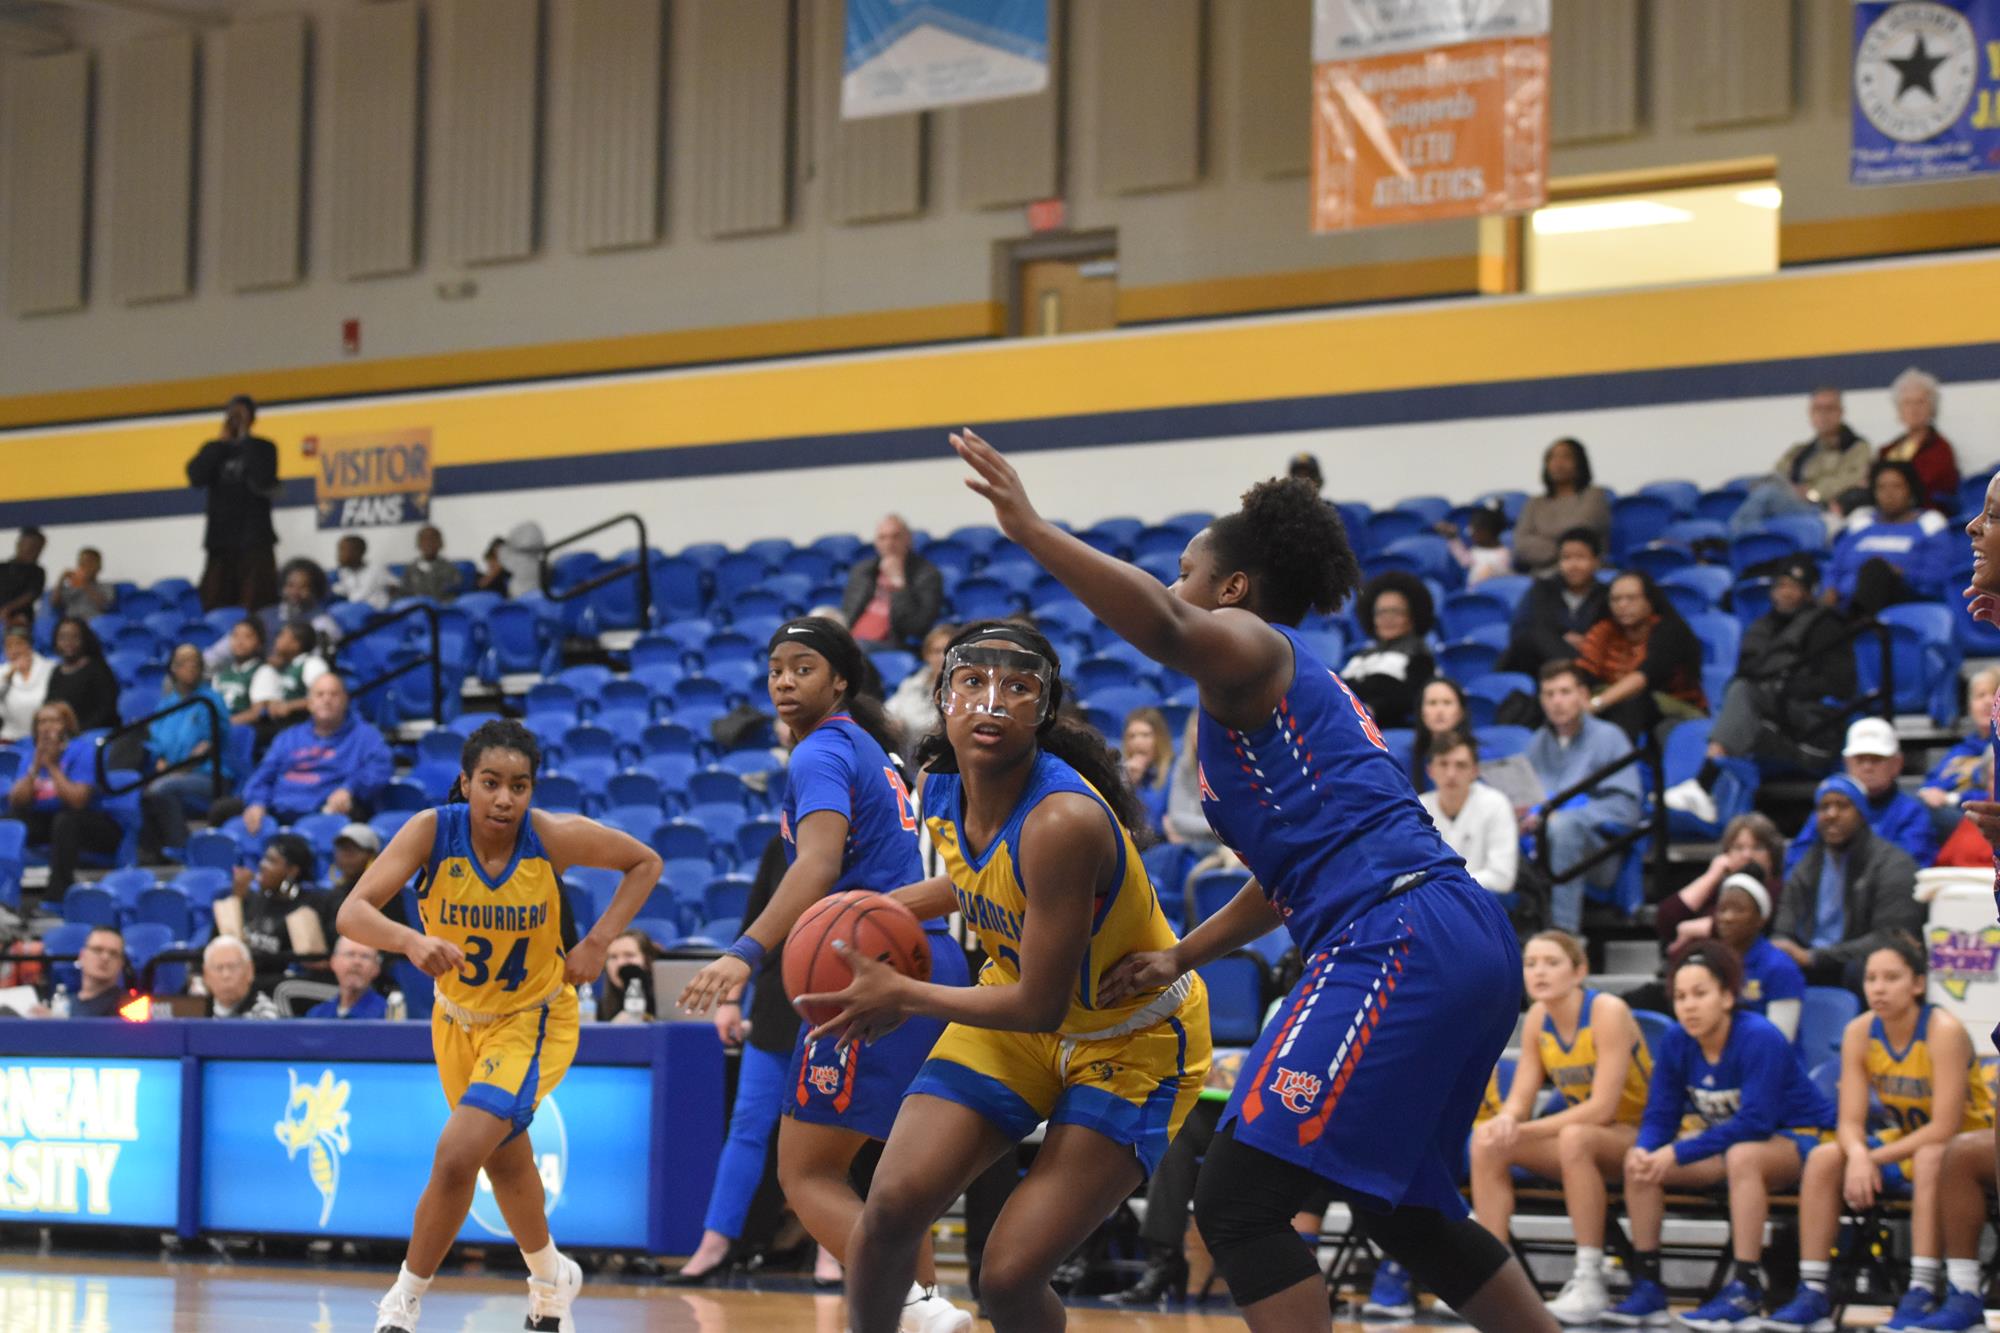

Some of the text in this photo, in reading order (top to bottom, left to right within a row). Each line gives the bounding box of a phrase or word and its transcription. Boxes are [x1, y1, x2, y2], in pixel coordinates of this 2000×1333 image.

[1371, 167, 1486, 208] ATHLETICS
[320, 443, 427, 488] VISITOR
[340, 493, 402, 526] FANS
[440, 898, 547, 931] LETOURNEAU
[459, 935, 530, 992] 34
[0, 1067, 140, 1141] NEAU
